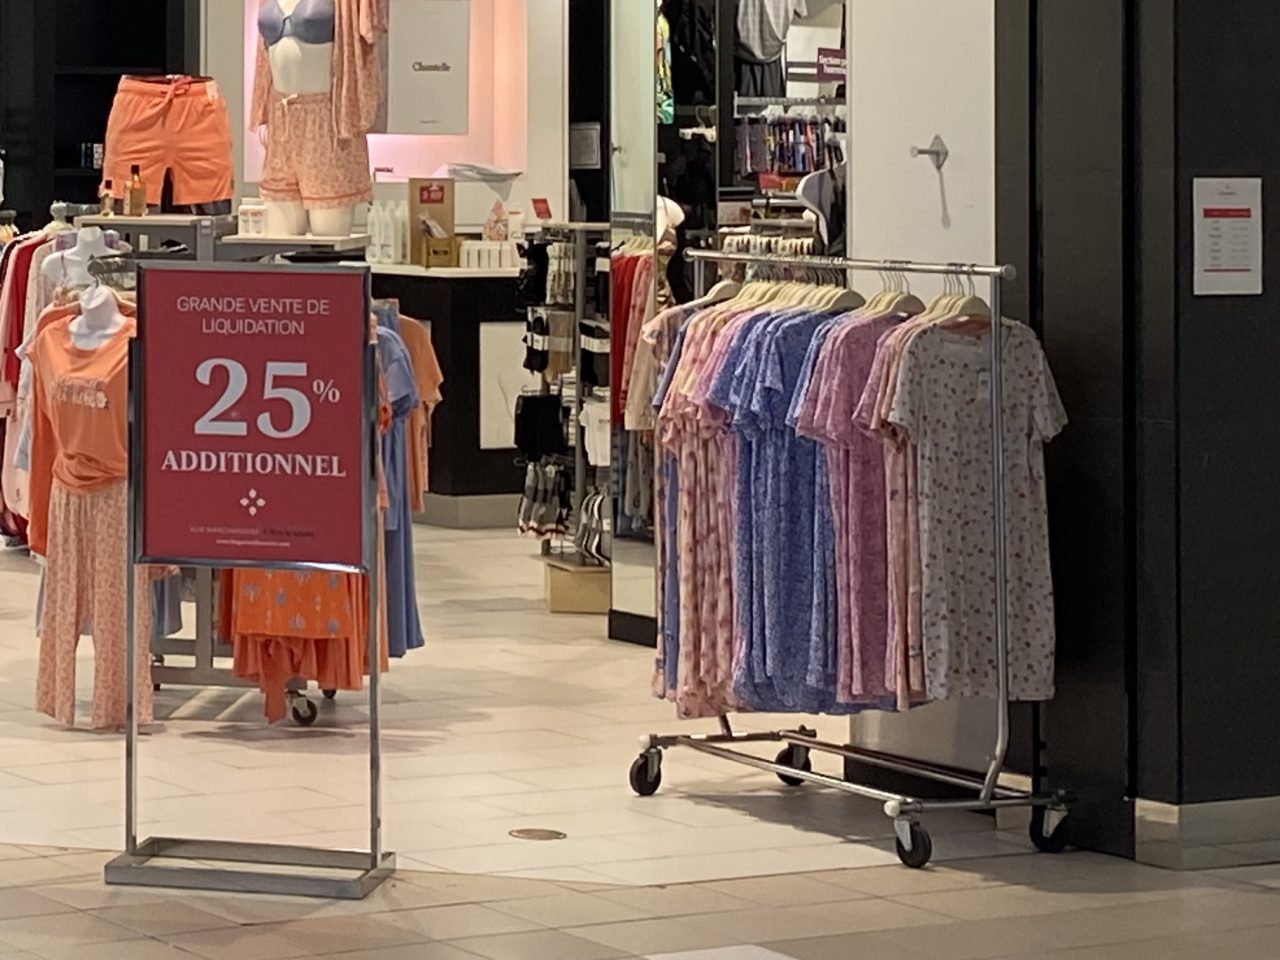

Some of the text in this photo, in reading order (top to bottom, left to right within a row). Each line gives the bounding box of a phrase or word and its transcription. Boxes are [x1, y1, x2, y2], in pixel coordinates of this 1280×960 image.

[176, 296, 330, 315] GRANDE VENTE DE
[202, 318, 305, 336] LIQUIDATION
[160, 449, 347, 477] ADDITIONNEL
